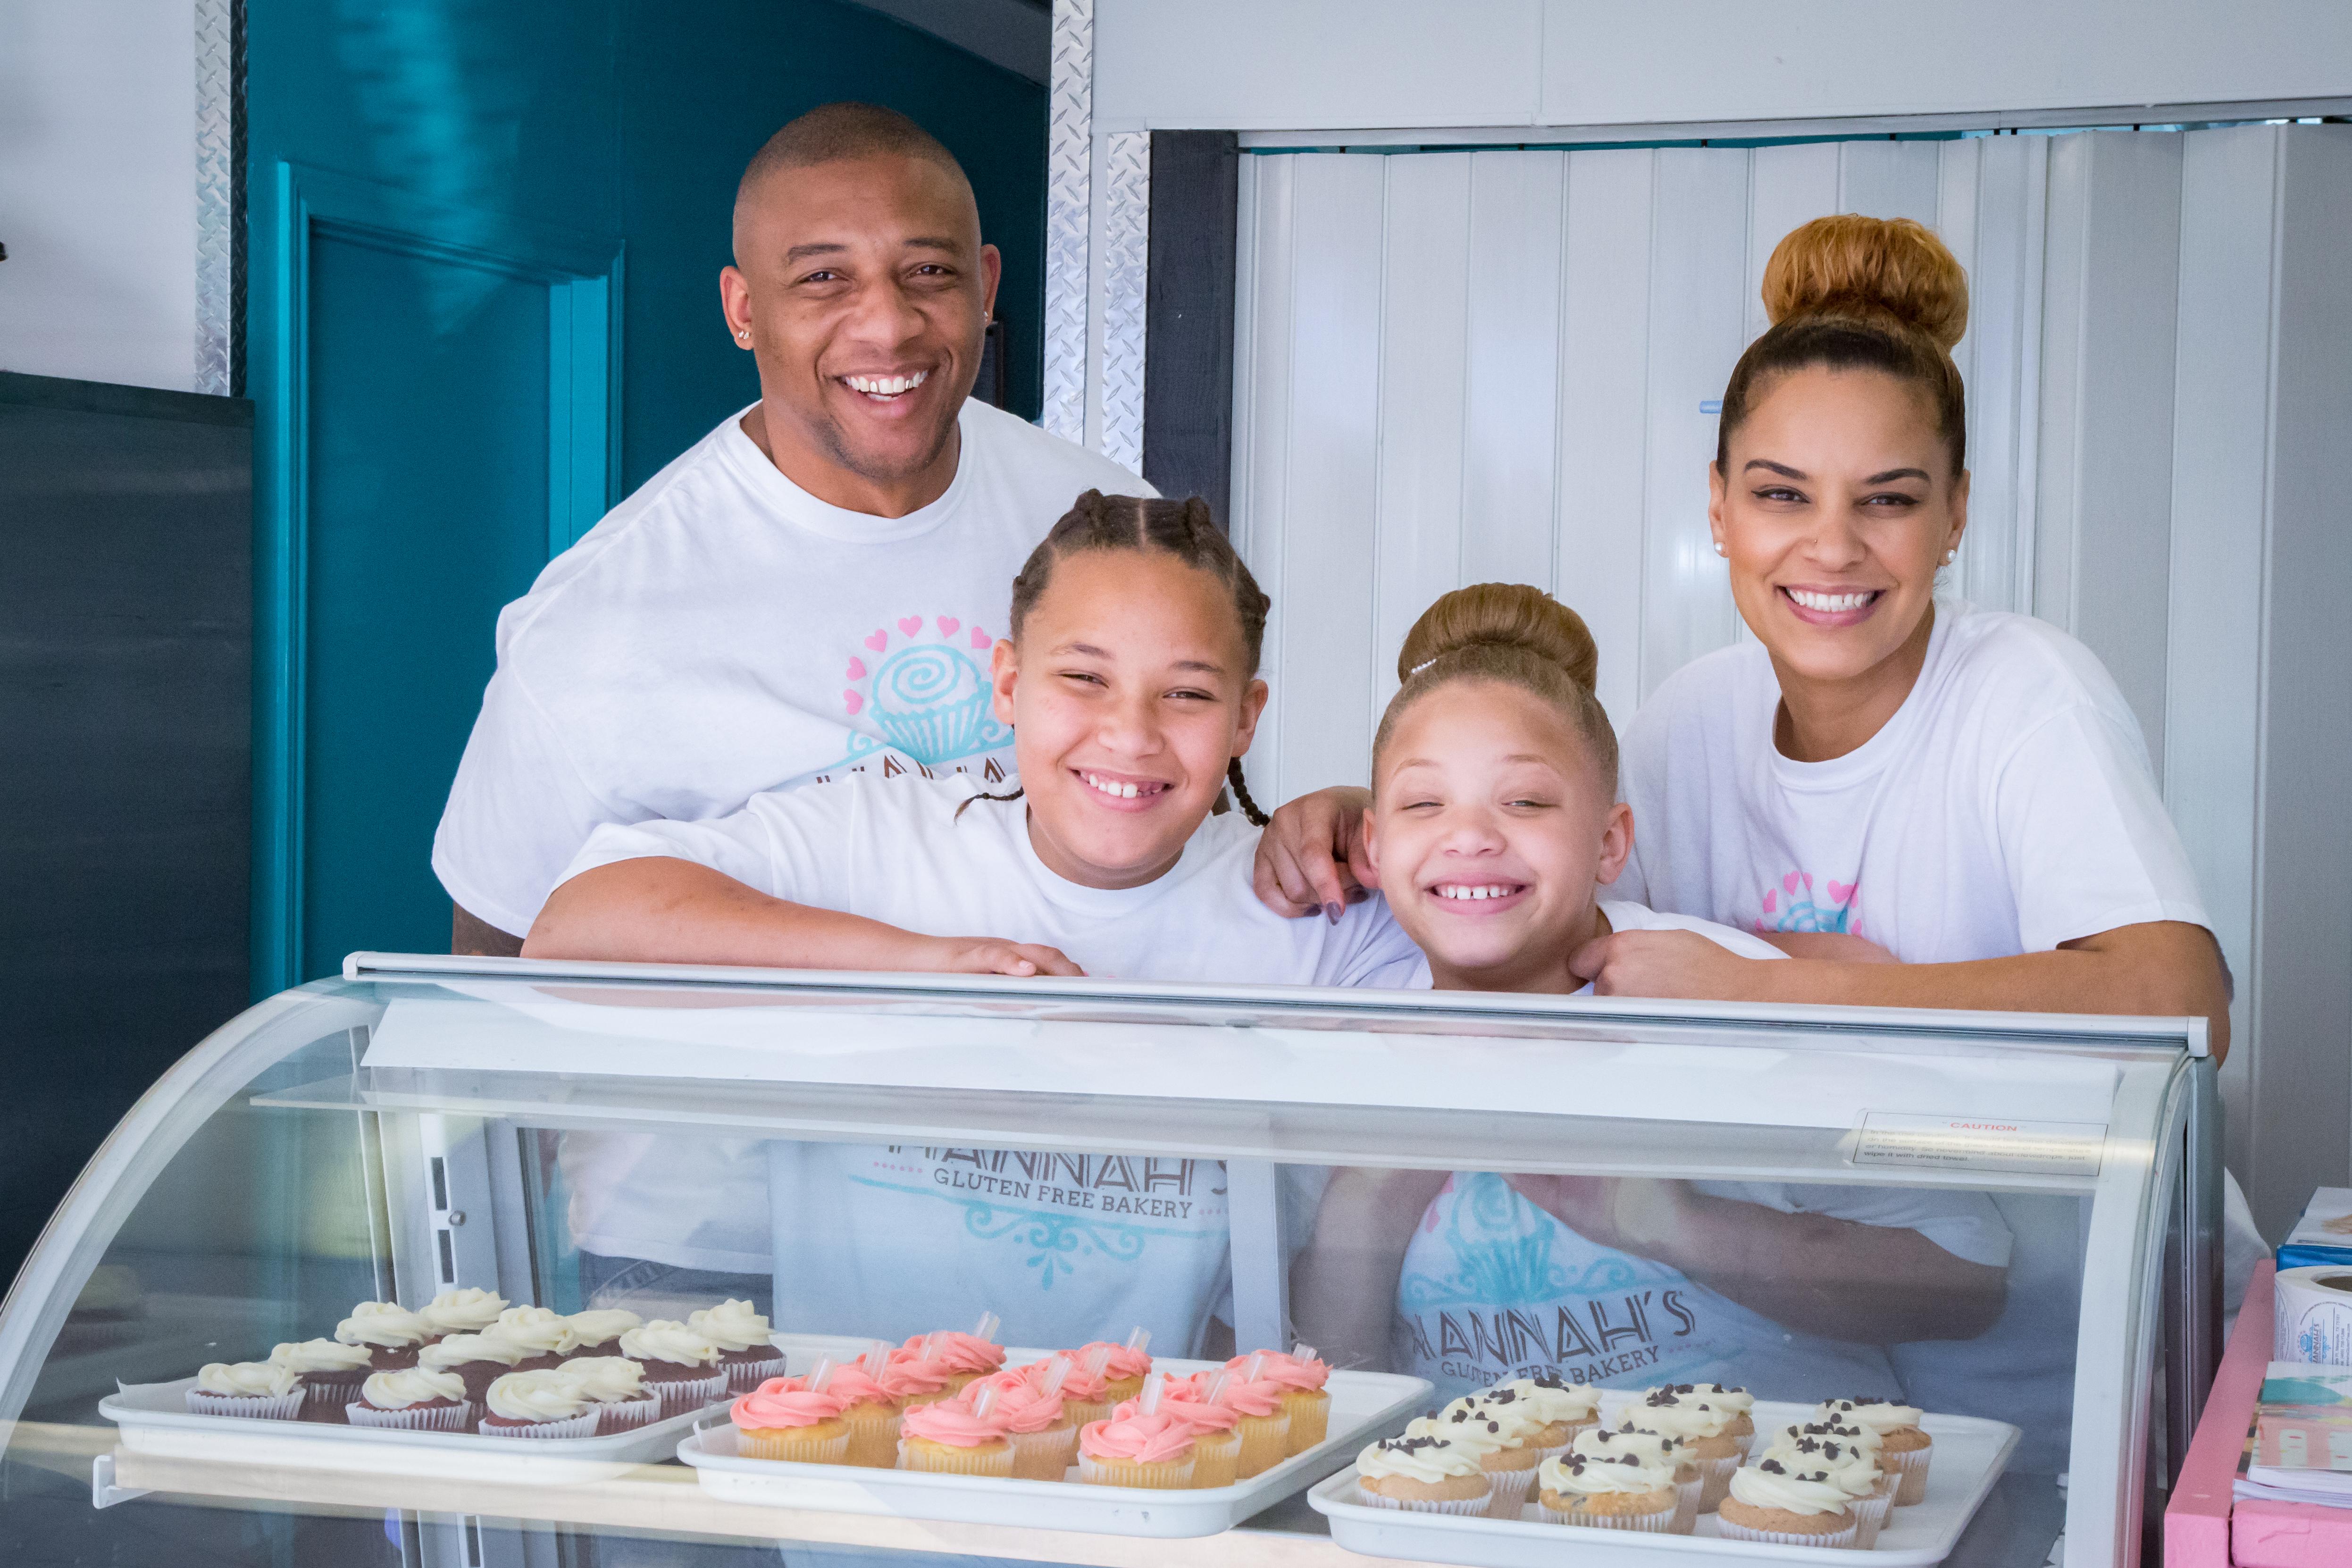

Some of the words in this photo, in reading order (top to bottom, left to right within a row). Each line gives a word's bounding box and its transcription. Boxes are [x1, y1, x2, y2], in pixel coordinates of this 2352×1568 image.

[1950, 1122, 2017, 1131] CAUTION
[934, 1168, 1030, 1199] GLUTEN
[1037, 1185, 1095, 1209] FREE
[1101, 1196, 1192, 1219] BAKERY
[1570, 1345, 1658, 1384] BAKERY
